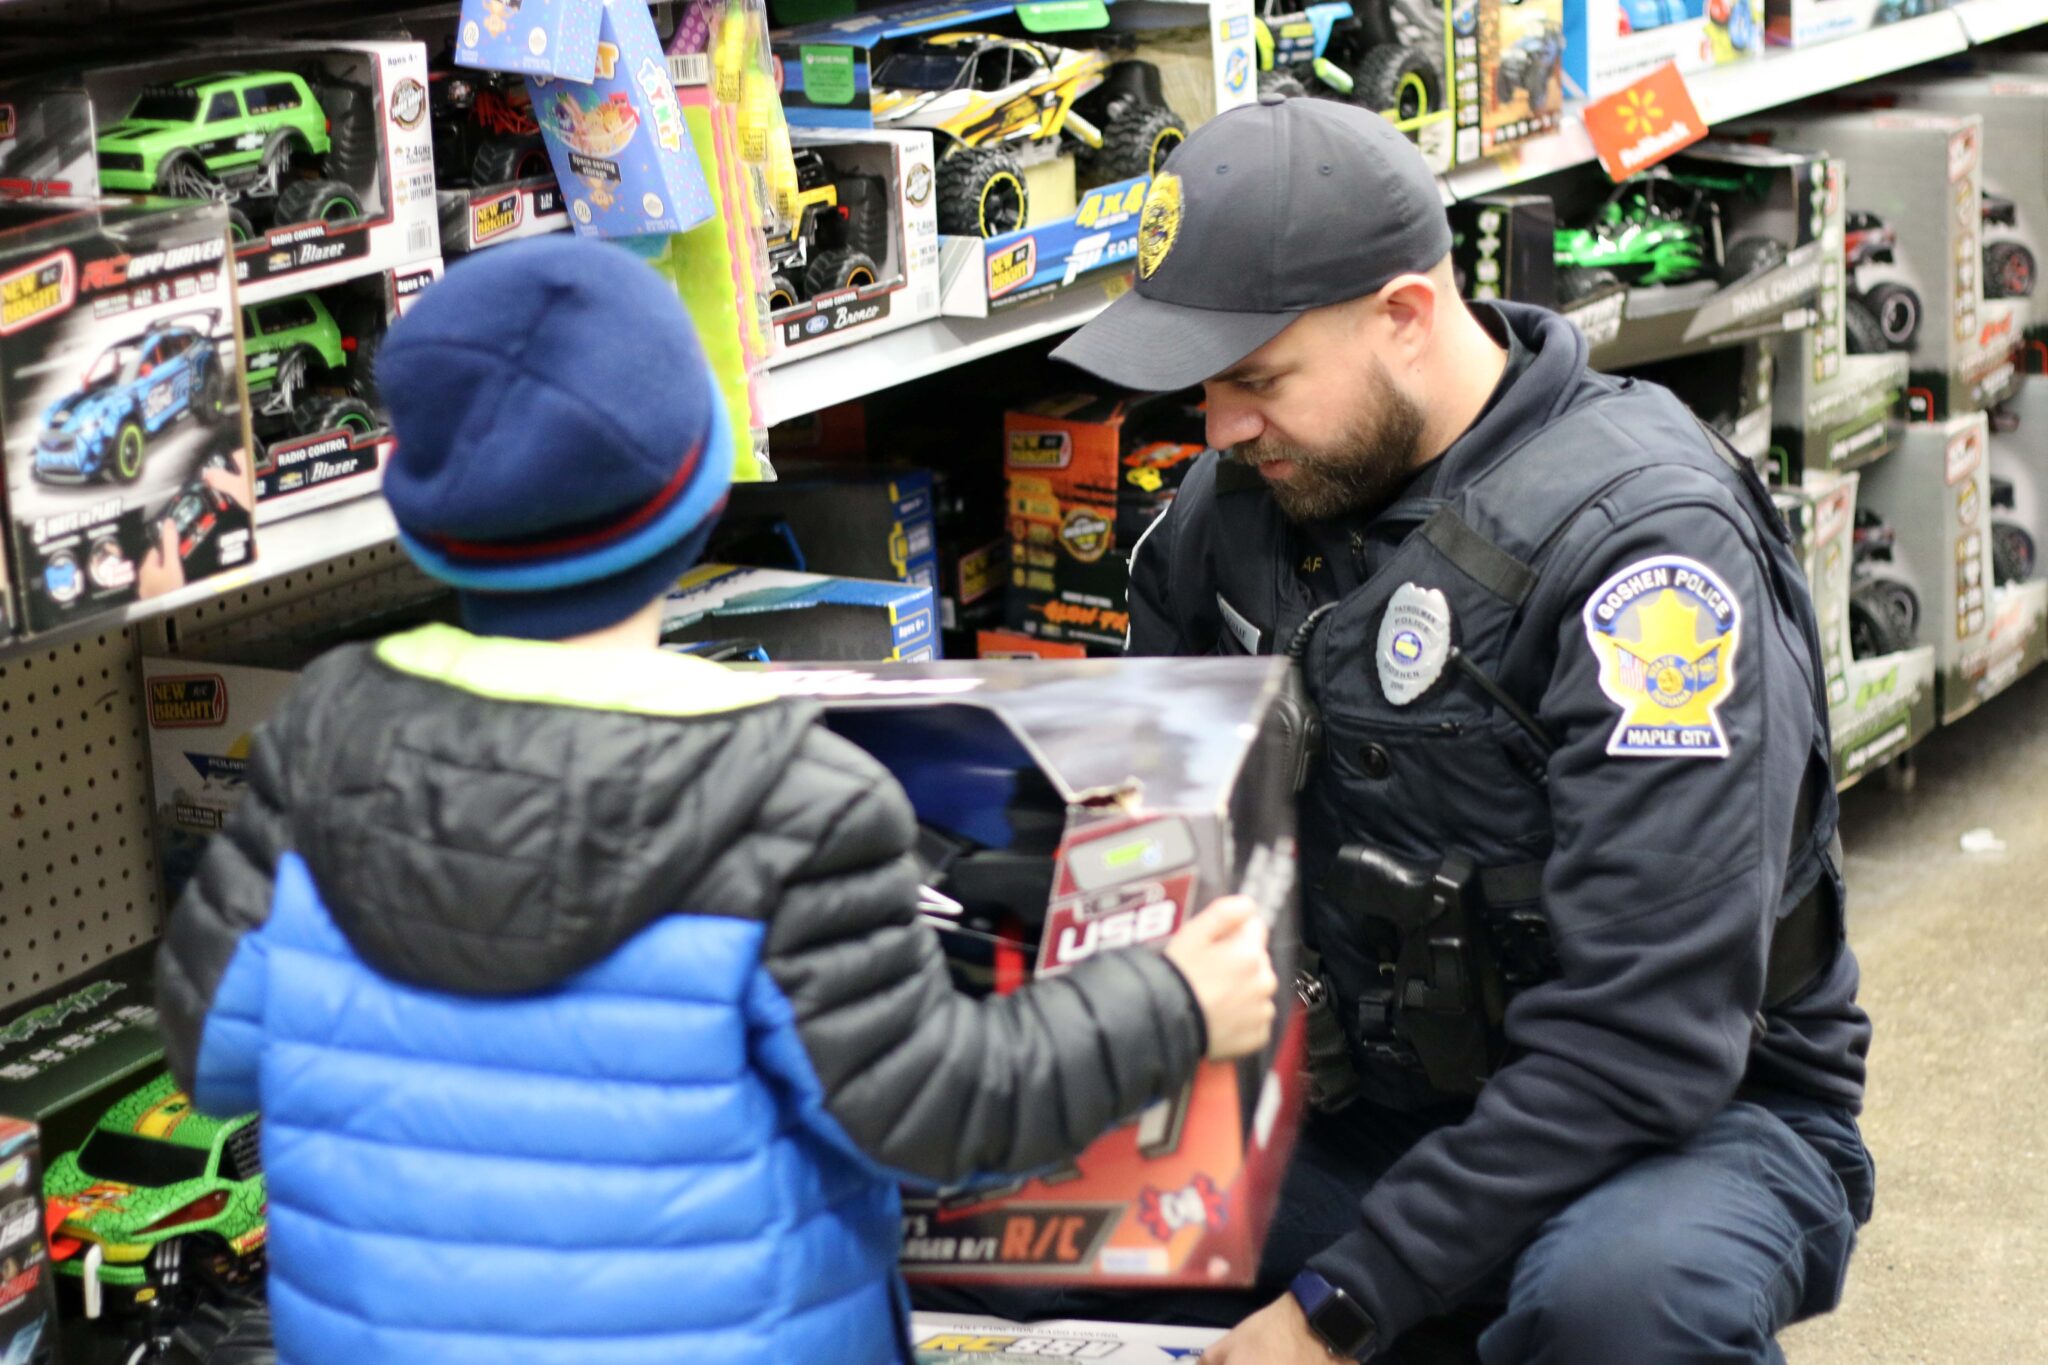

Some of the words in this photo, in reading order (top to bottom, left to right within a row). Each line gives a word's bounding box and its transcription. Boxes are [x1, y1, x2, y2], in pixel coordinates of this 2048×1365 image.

[477, 203, 500, 221] NEW
[477, 211, 515, 235] BRIGHT
[271, 230, 293, 247] RADIO
[294, 226, 325, 241] CONTROL
[300, 242, 346, 264] Blazer
[3, 273, 38, 299] NEW
[398, 278, 418, 295] Ages
[833, 304, 880, 330] Bronco
[278, 448, 306, 466] RADIO
[308, 437, 347, 459] CONTROL
[311, 459, 358, 482] Blazer
[1598, 567, 1668, 620] GOSHEN
[1674, 568, 1731, 618] POLICE
[1394, 617, 1431, 635] POLICE
[1384, 662, 1421, 680] GOSHEN
[154, 682, 186, 700] NEW
[155, 702, 210, 721] BRIGHT
[1628, 729, 1676, 746] MAPLE
[1680, 730, 1712, 746] CITY
[1057, 900, 1177, 963] USB
[1002, 1215, 1086, 1263] R/C
